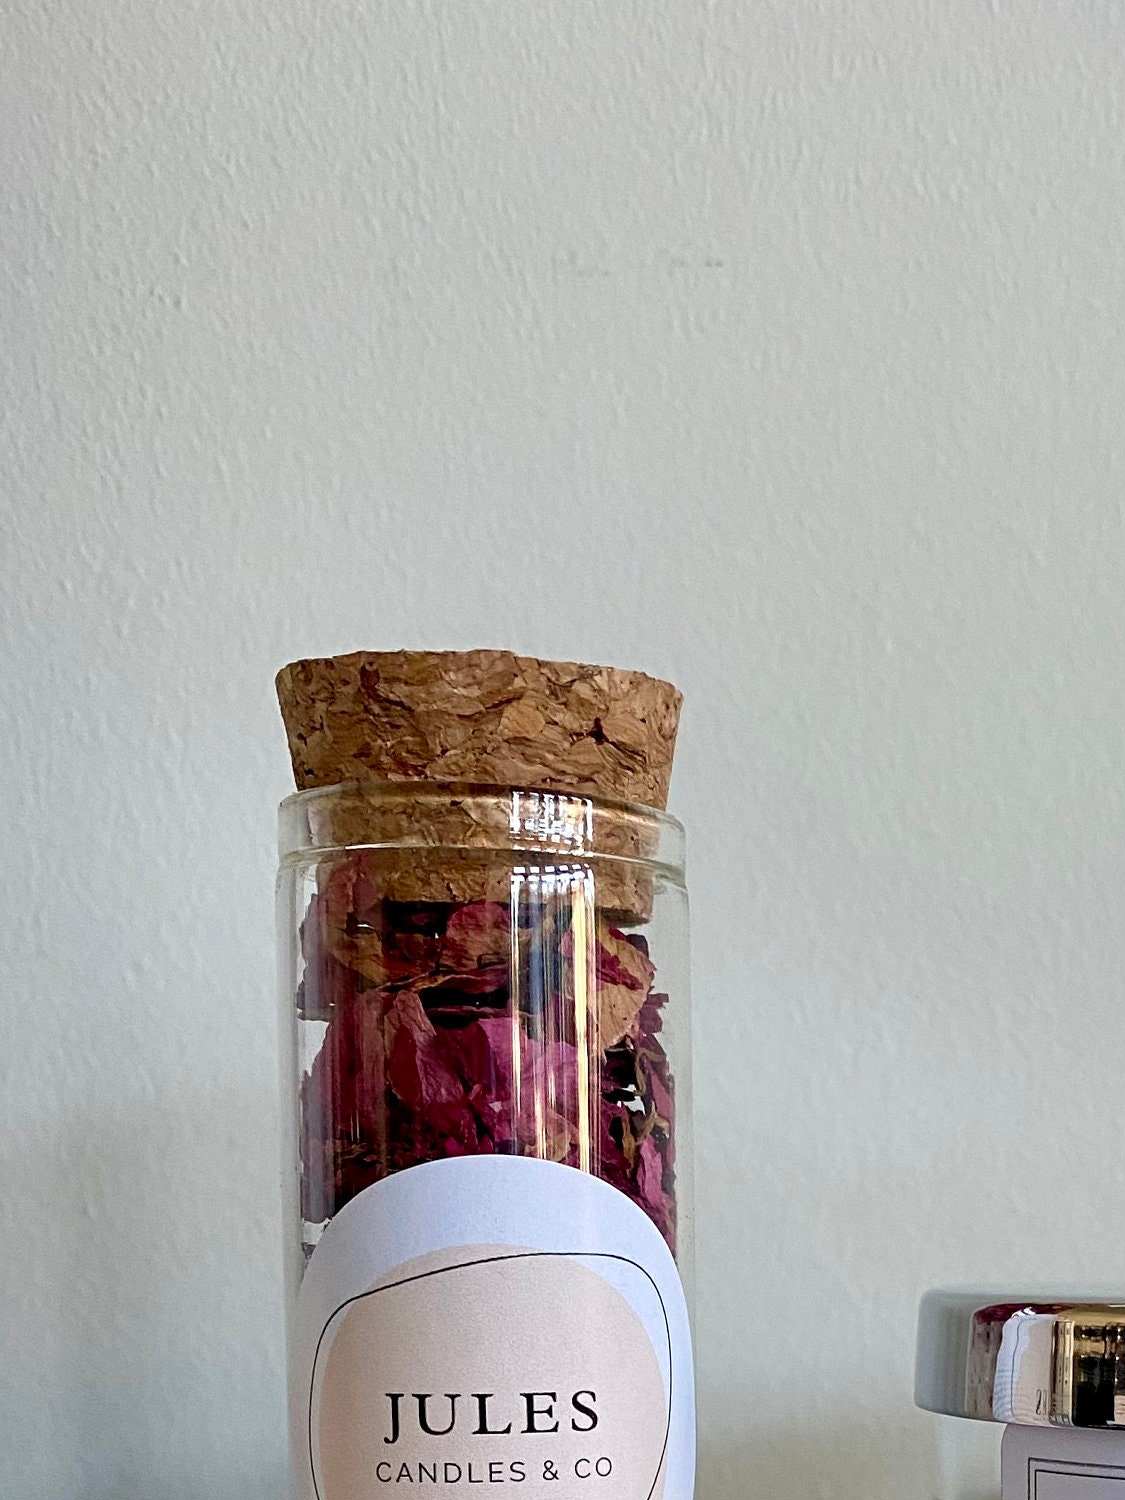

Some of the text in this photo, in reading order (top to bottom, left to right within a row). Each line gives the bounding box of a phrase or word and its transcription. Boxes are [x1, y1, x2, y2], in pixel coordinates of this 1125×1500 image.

[383, 1390, 599, 1445] JULES
[375, 1456, 613, 1484] CANDLES & CO
